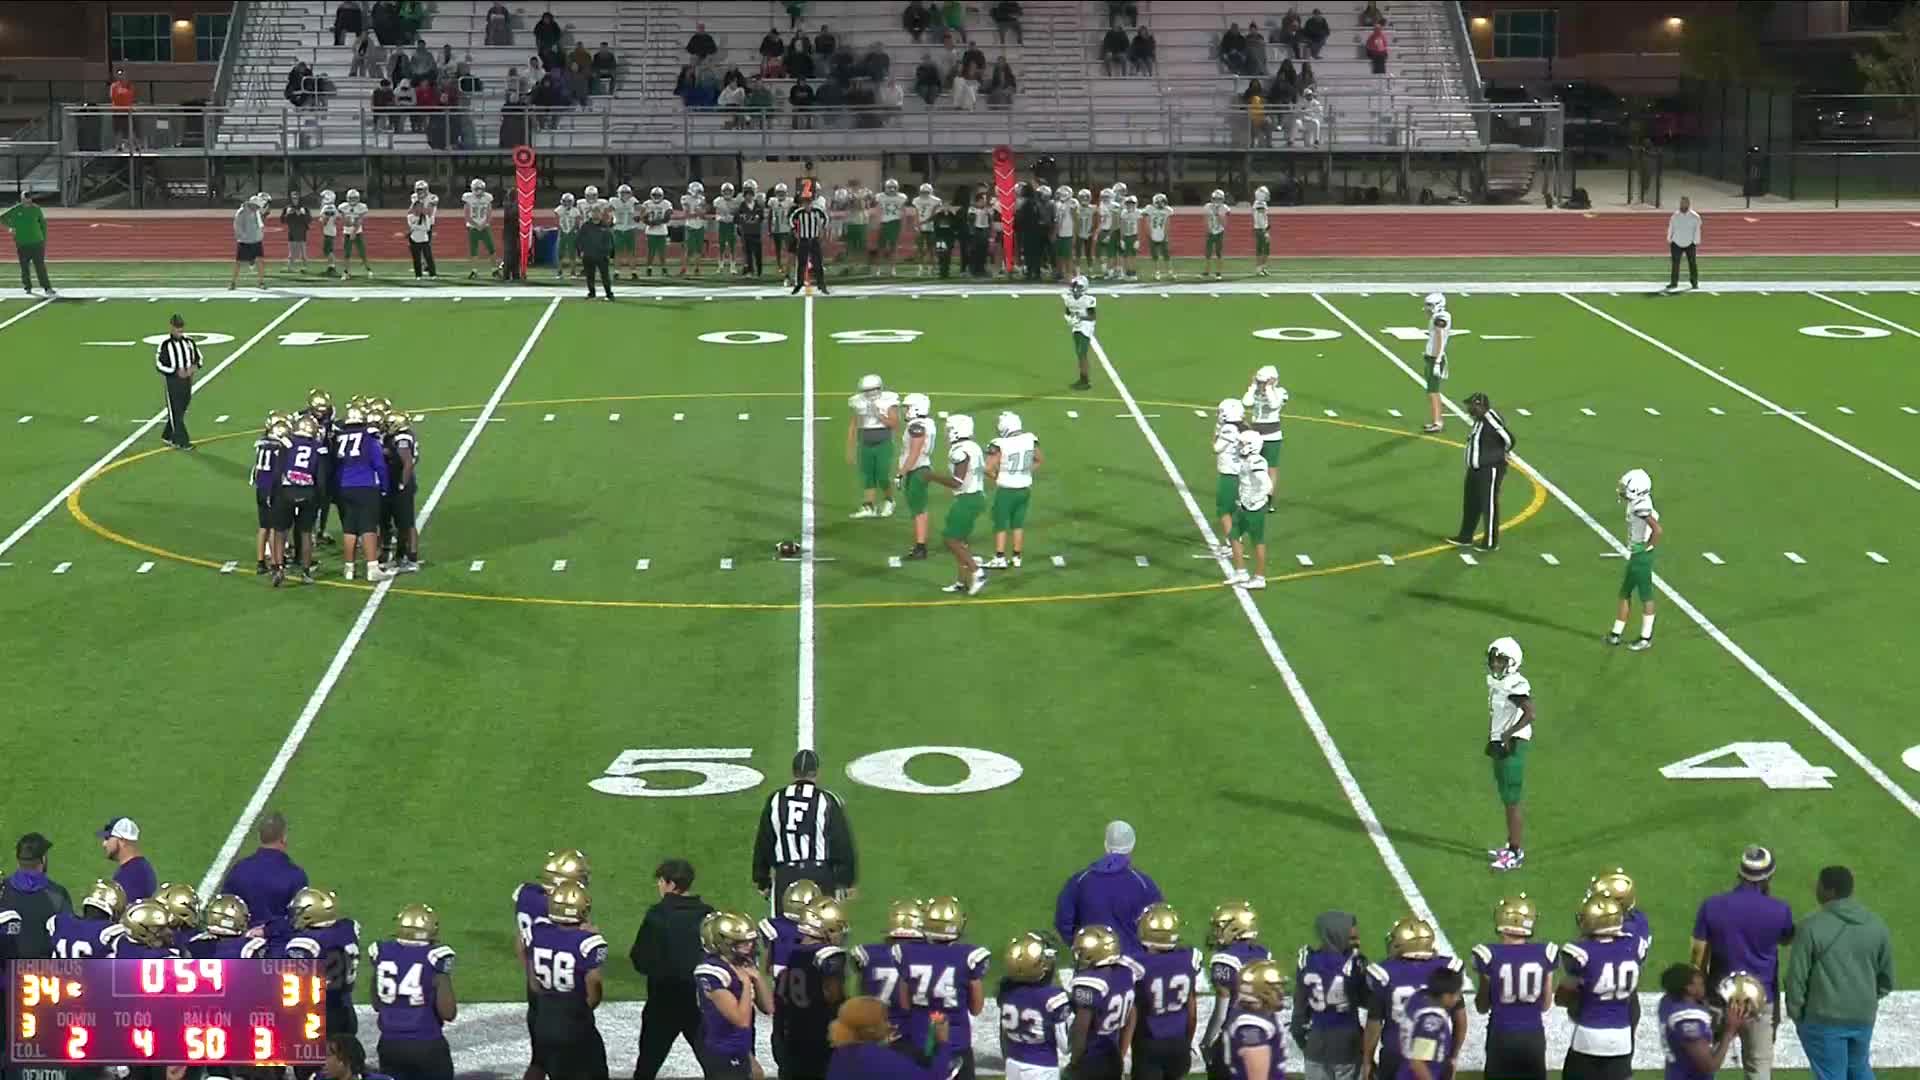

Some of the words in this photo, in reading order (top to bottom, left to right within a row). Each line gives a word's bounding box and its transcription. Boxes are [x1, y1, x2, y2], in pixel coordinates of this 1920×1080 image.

[294, 445, 312, 468] 2
[337, 432, 363, 457] 77
[786, 800, 808, 832] F
[377, 961, 425, 1006] 64
[909, 964, 958, 1008] 74
[1150, 974, 1191, 1015] 13
[1303, 973, 1348, 1013] 34
[1499, 962, 1542, 1003] 10
[1593, 960, 1639, 1000] 40
[1001, 1003, 1045, 1044] 23
